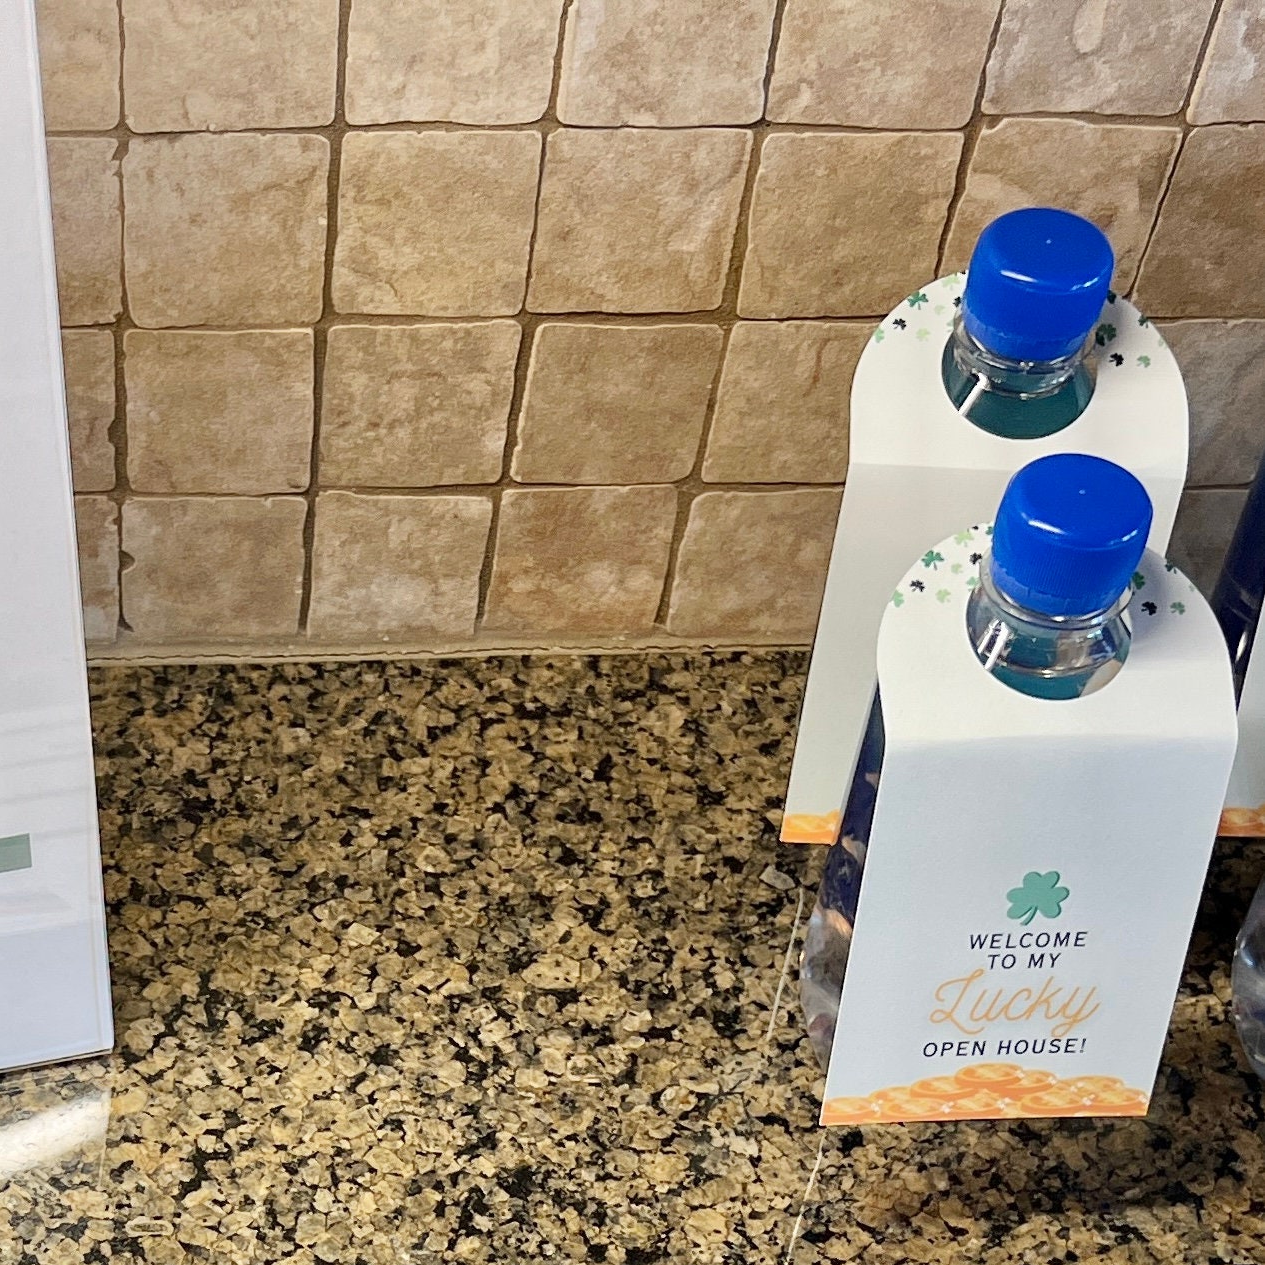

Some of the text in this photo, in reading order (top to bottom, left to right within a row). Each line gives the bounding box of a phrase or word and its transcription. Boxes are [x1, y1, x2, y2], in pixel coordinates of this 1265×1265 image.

[969, 931, 1088, 950] WELCOME
[988, 952, 1061, 970] TO MY
[929, 968, 1101, 1037] Lucky
[922, 1038, 1087, 1057] OPEN HOUSE!
